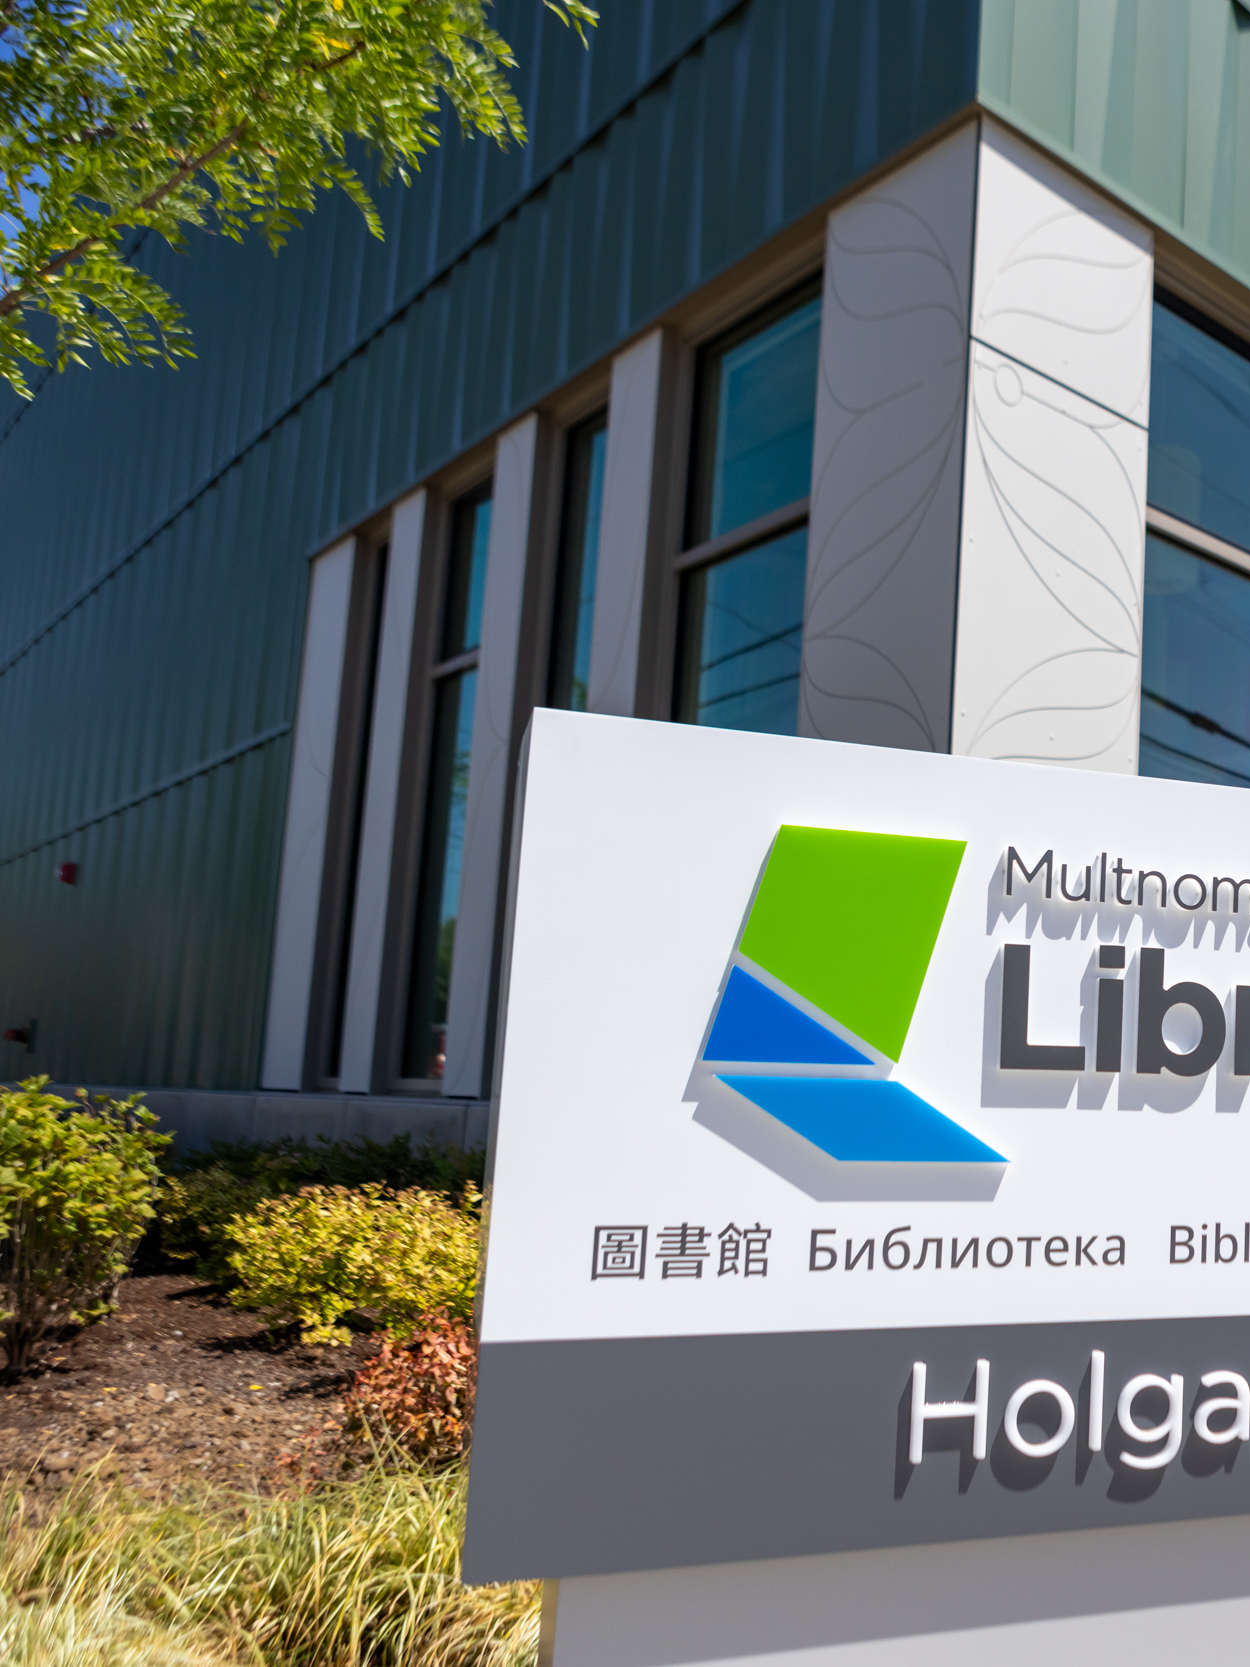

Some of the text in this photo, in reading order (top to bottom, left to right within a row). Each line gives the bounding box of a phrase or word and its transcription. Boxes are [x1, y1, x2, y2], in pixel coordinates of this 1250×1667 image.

[590, 1222, 772, 1281] 圖書館
[808, 1225, 1127, 1272] Библиотека
